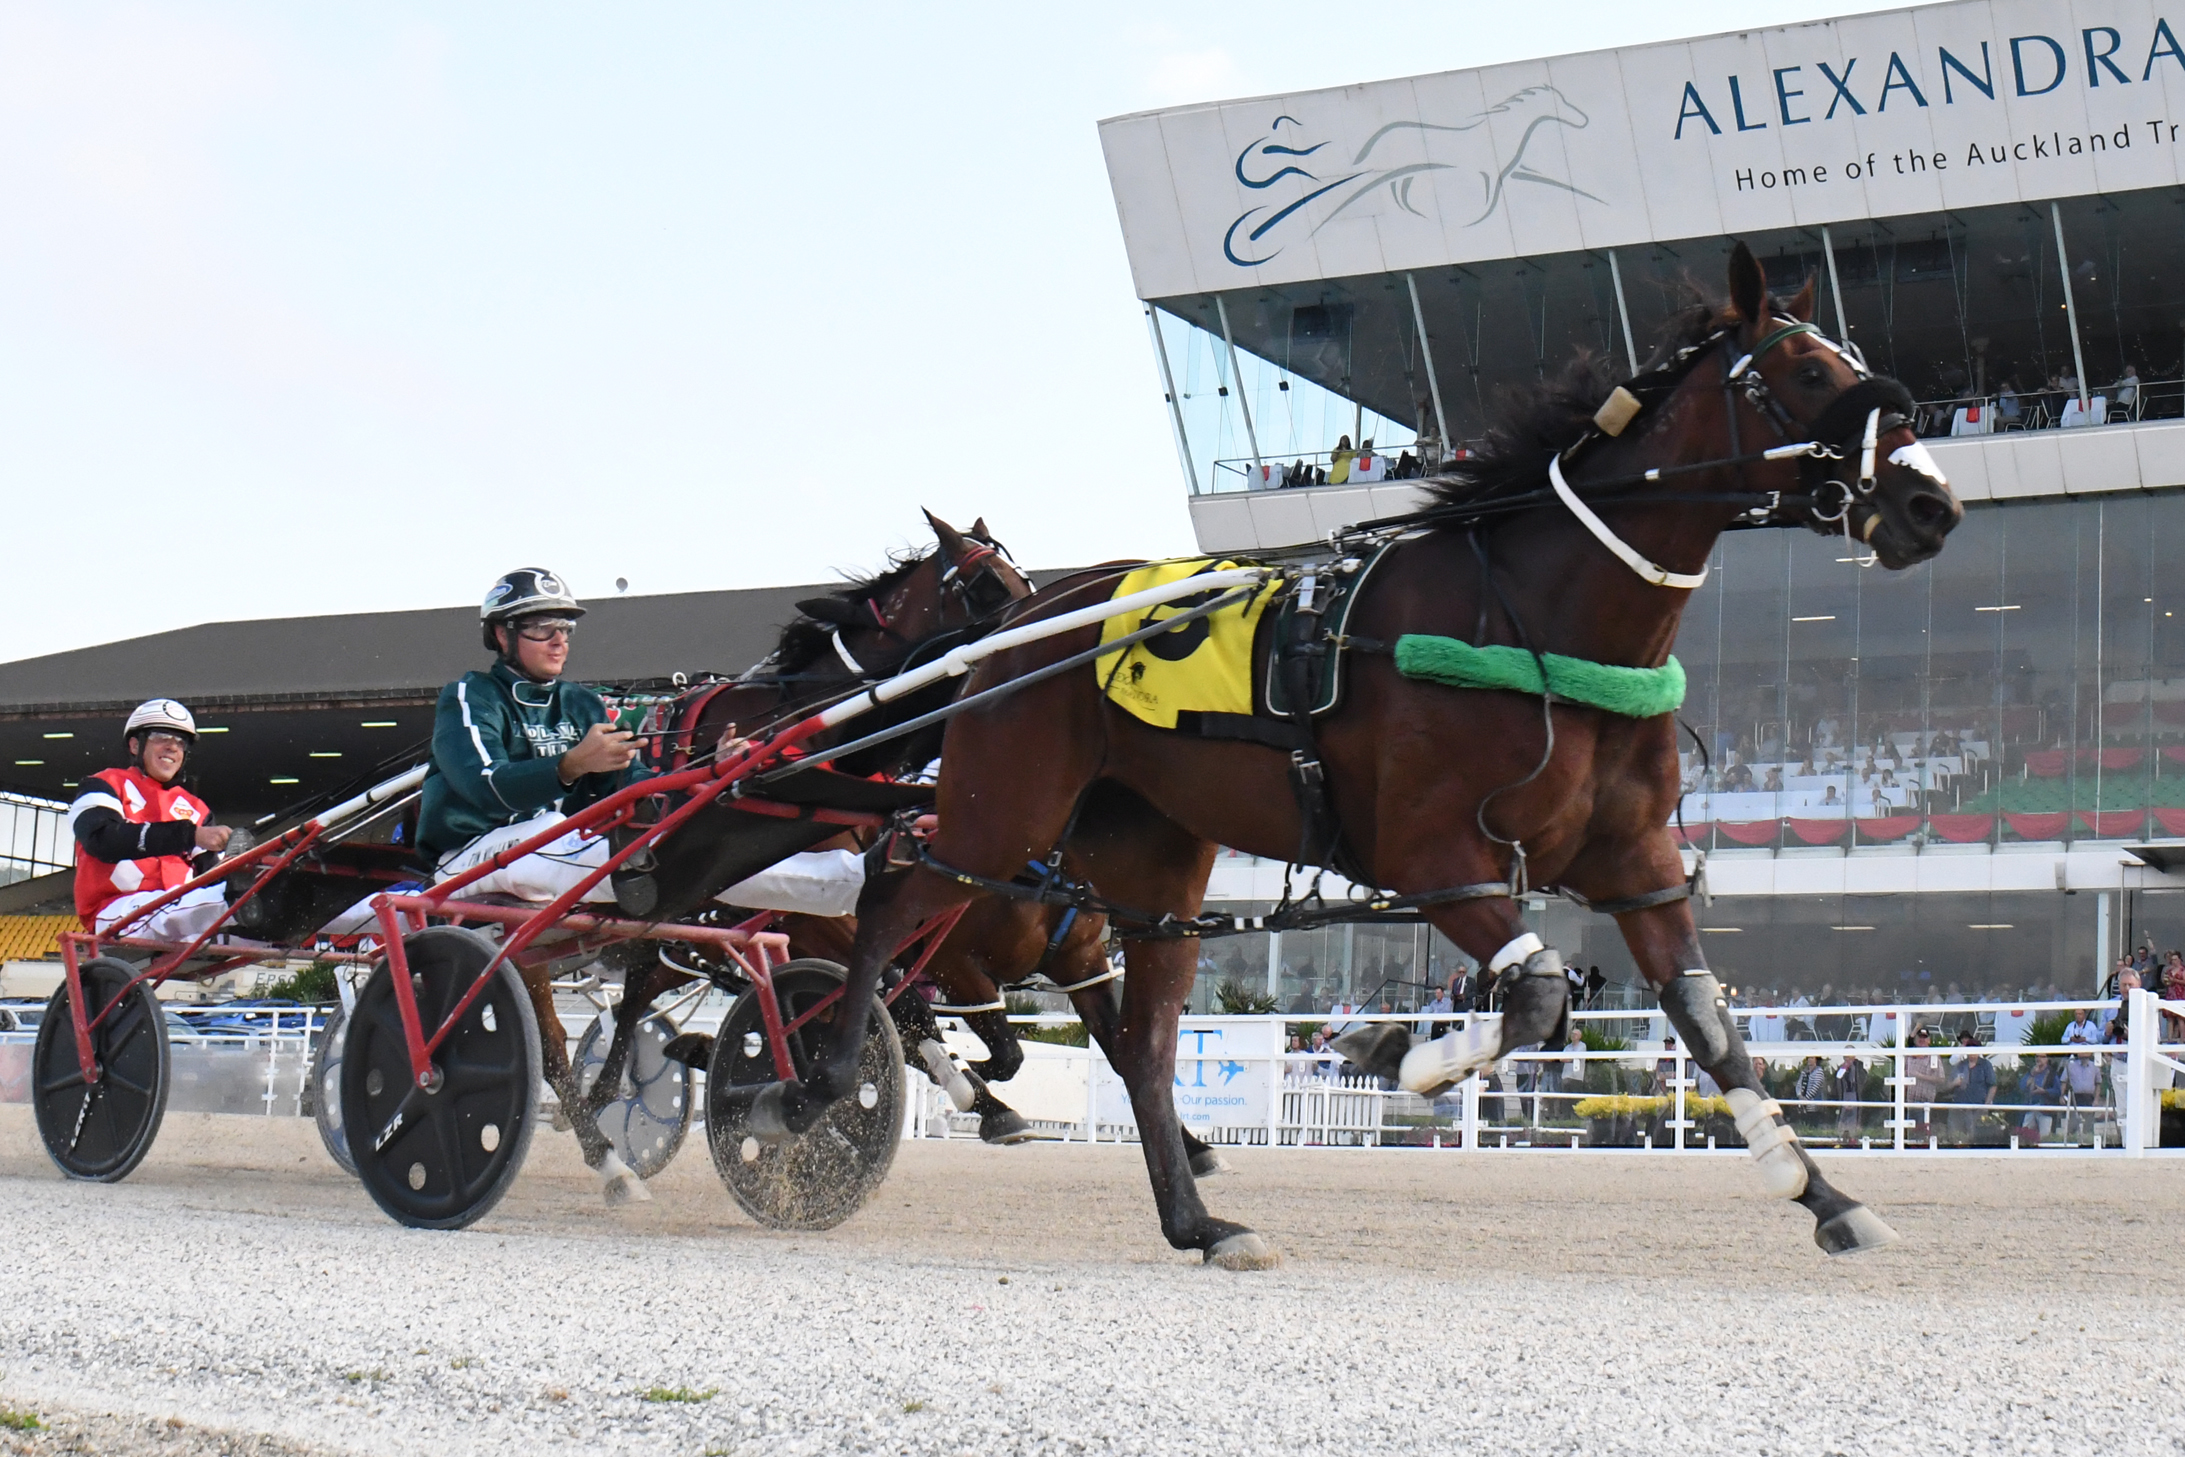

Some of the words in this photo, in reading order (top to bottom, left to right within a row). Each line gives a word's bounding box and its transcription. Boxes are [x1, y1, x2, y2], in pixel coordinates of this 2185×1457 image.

[1674, 17, 2185, 140] ALEXANDRA
[1735, 163, 1828, 191] Home
[1845, 153, 1877, 180] of
[1893, 150, 1949, 175] the
[1967, 125, 2131, 166] Auckland
[2146, 120, 2179, 144] Tr
[1182, 1094, 1202, 1105] Our
[1204, 1094, 1248, 1107] passion.
[375, 1112, 403, 1153] LZR
